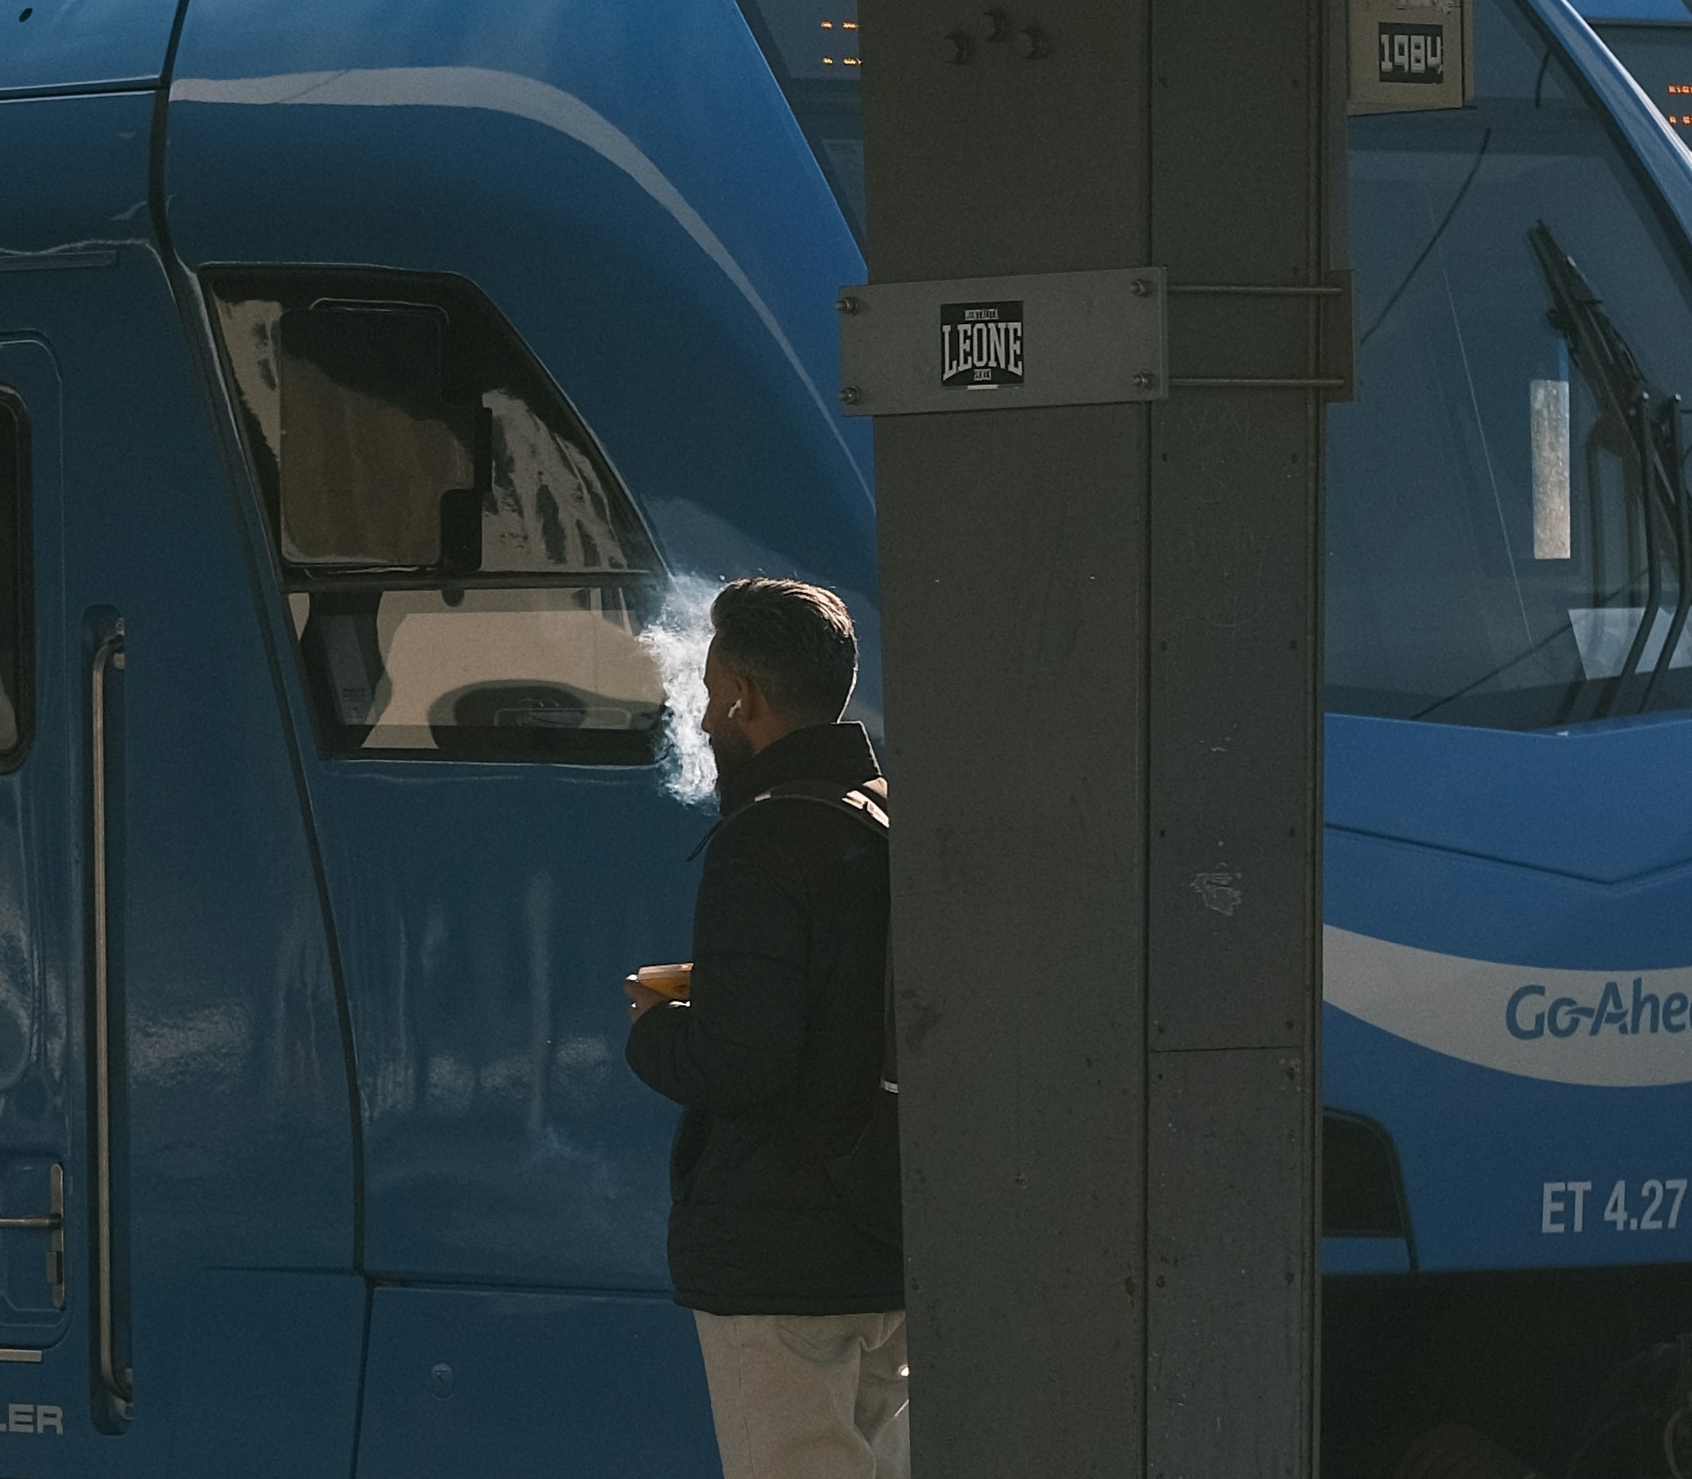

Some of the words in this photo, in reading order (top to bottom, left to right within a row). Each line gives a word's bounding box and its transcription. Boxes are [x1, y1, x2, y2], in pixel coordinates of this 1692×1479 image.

[1380, 33, 1442, 74] 1984
[942, 321, 1023, 381] LEONE
[1541, 1181, 1592, 1234] ET
[1604, 1178, 1688, 1233] 4.27
